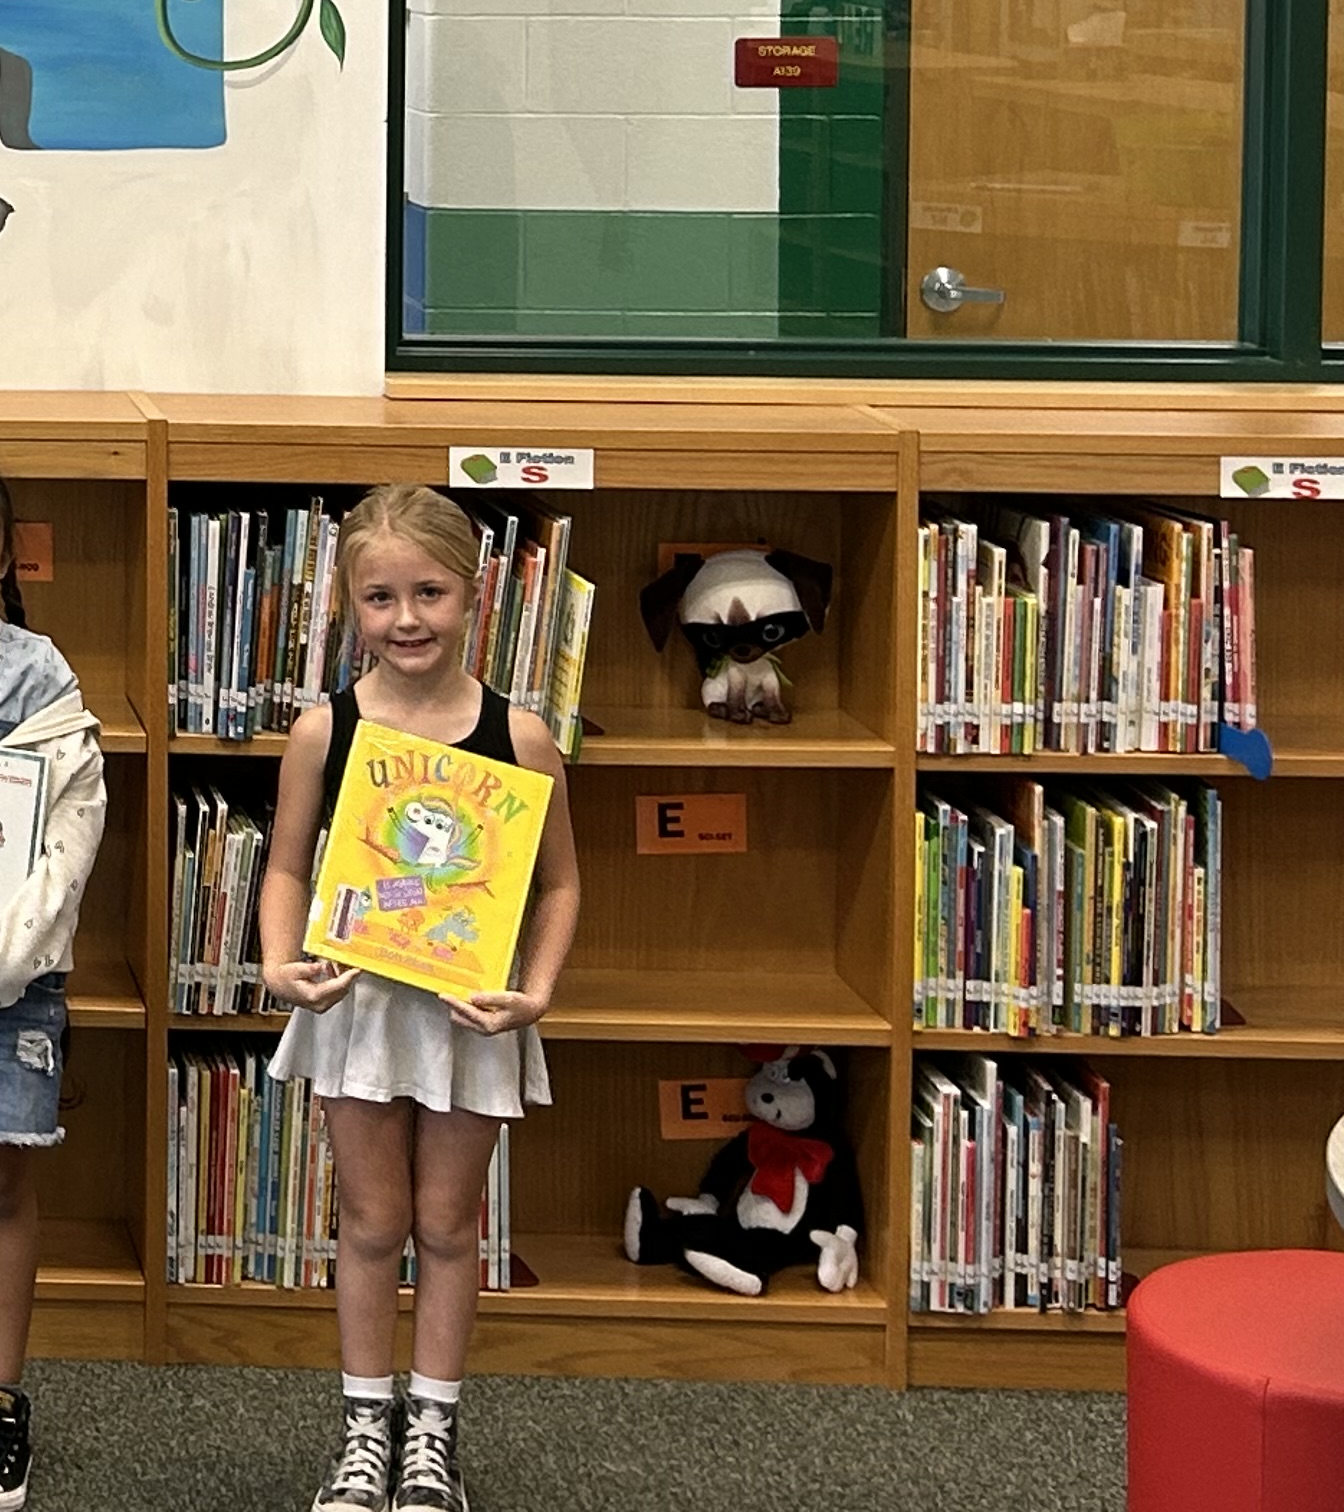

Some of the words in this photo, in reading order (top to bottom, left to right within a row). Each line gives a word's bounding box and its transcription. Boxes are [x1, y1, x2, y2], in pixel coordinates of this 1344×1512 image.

[758, 45, 816, 57] STORAGE
[516, 452, 575, 464] Fiction
[521, 465, 549, 484] S
[1292, 478, 1321, 500] S
[365, 749, 531, 825] UNICORN
[658, 802, 685, 838] E
[681, 1084, 709, 1120] E
